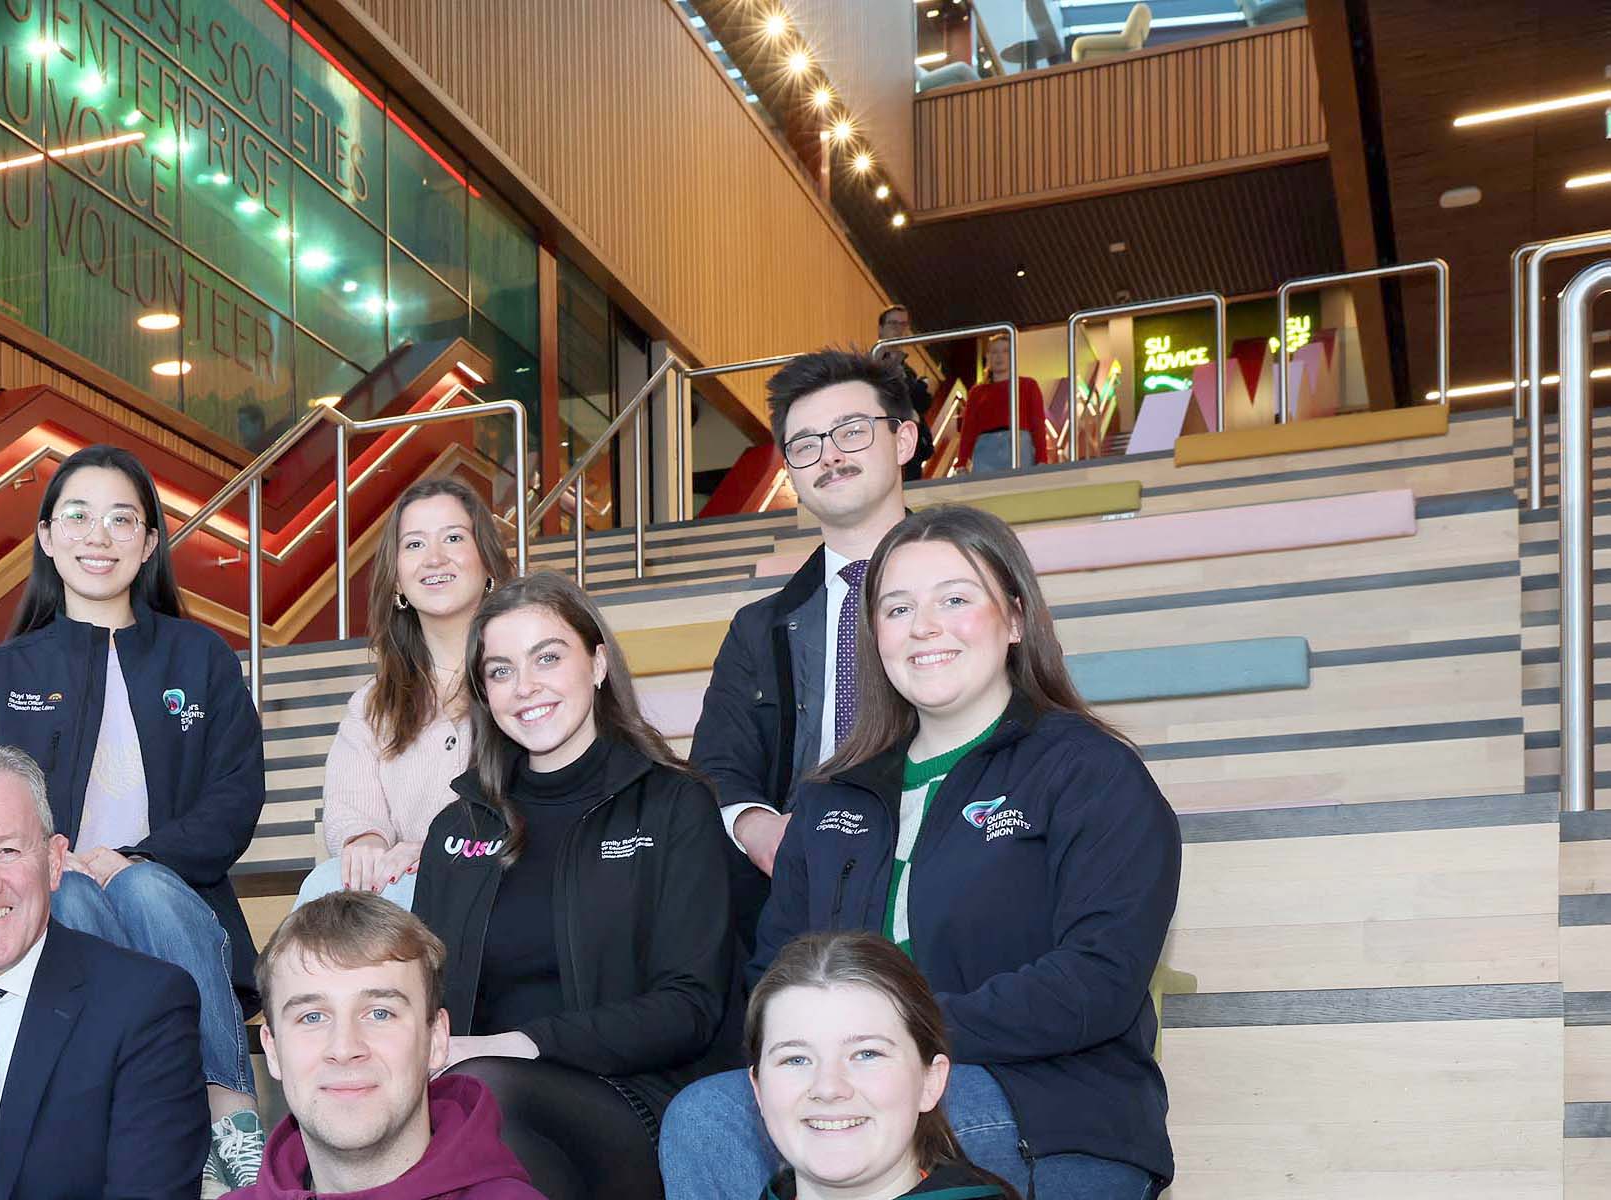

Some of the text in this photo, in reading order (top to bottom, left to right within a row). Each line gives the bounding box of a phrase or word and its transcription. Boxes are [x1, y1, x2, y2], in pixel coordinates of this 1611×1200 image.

[48, 78, 173, 228] VOICE
[47, 180, 277, 384] VOLUNTEER
[1144, 335, 1171, 355] SU
[1144, 346, 1210, 372] ADVICE
[986, 809, 1025, 824] QUEEN'S
[986, 826, 1015, 842] UNION
